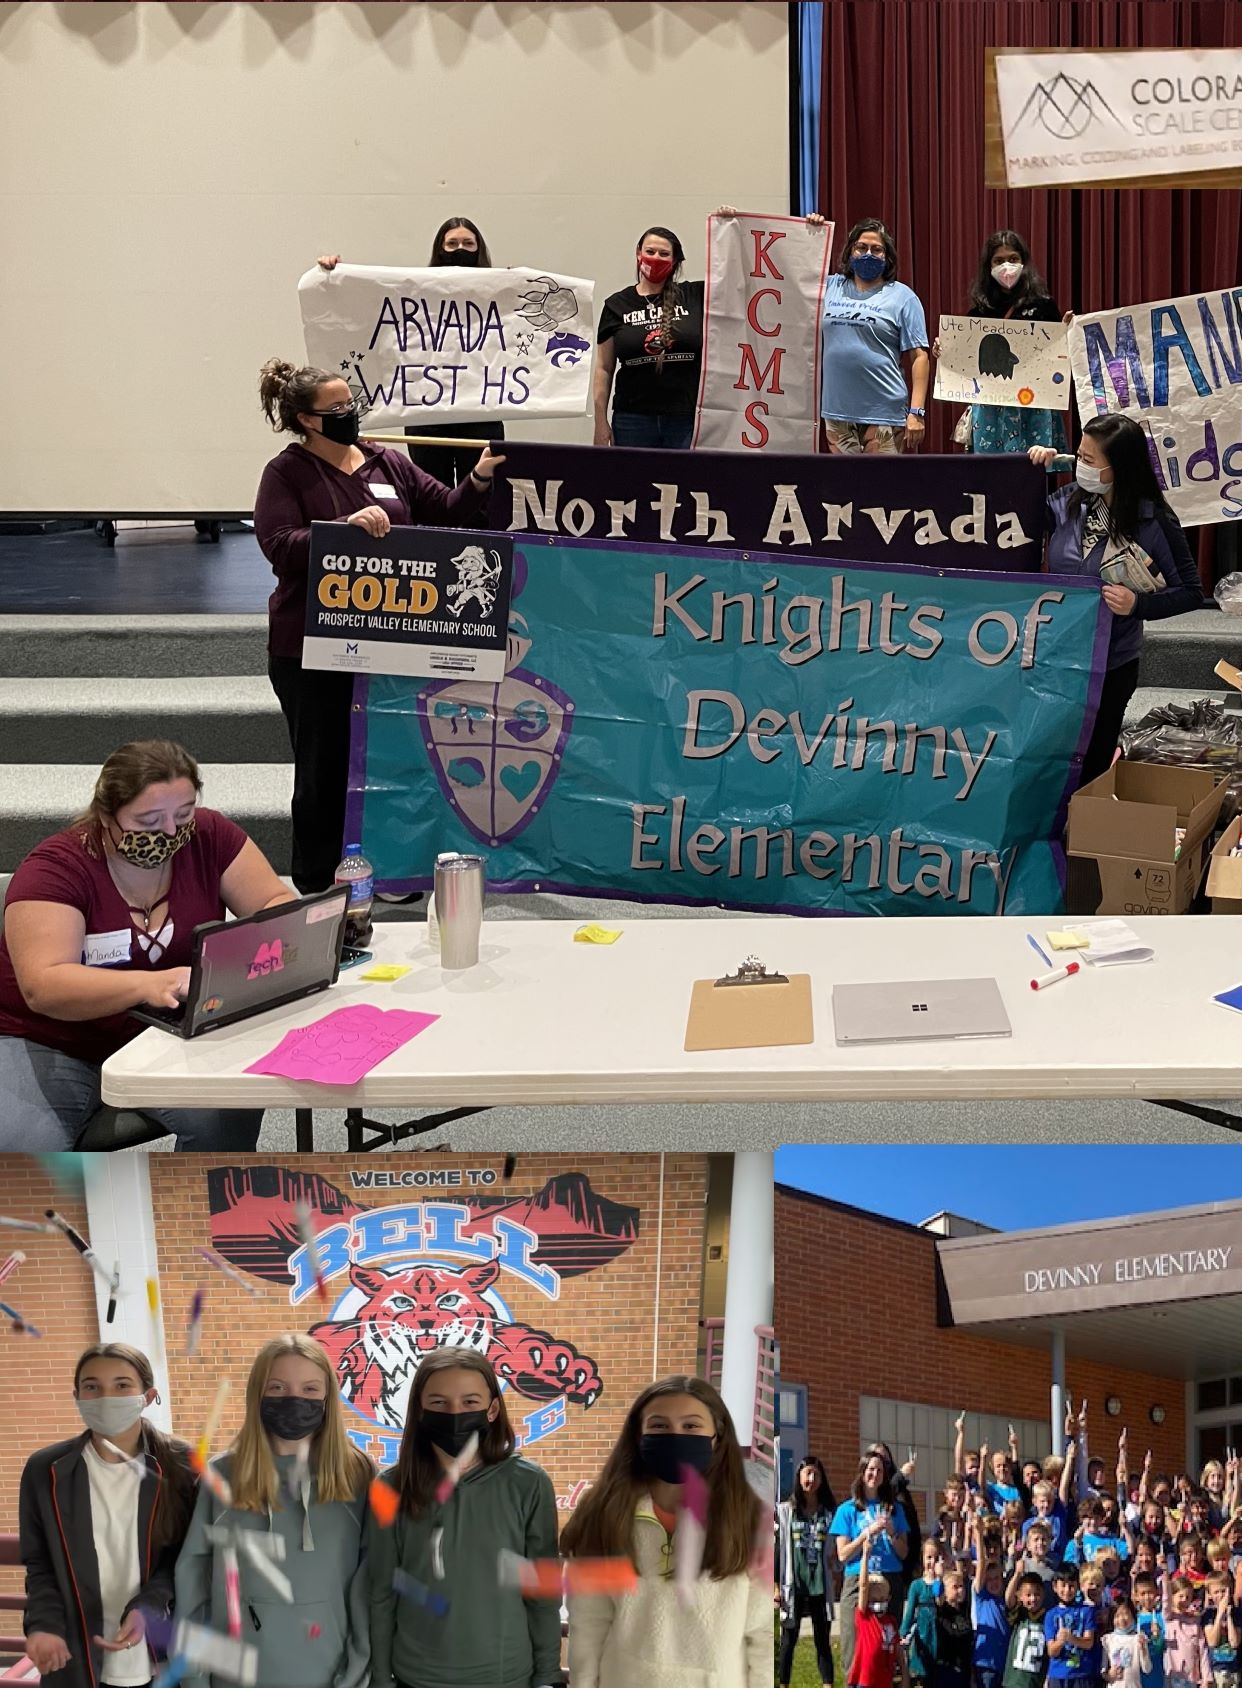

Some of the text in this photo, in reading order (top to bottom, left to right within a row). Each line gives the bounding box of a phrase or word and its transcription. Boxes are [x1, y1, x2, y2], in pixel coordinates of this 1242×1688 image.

[1132, 109, 1205, 137] SCALE
[369, 296, 506, 353] ARVADA
[623, 305, 689, 324] KEN CAYL
[941, 320, 963, 331] Ute
[354, 362, 530, 408] WEST HS
[507, 478, 1035, 549] North Arvada
[322, 554, 436, 577] GO FOR THE
[318, 574, 439, 614] GOLD
[318, 612, 498, 638] PROSPECT VALLEY ELEMENTARY SCHOOL
[651, 572, 1065, 669] Knights of
[681, 689, 998, 800] Devinny
[1153, 874, 1164, 882] 72
[248, 959, 279, 976] Tech
[351, 1168, 497, 1189] WELCOME TO
[288, 1202, 561, 1306] BELL
[1025, 1263, 1103, 1293] DEVINNY
[1115, 1246, 1232, 1282] ELEMENTARY
